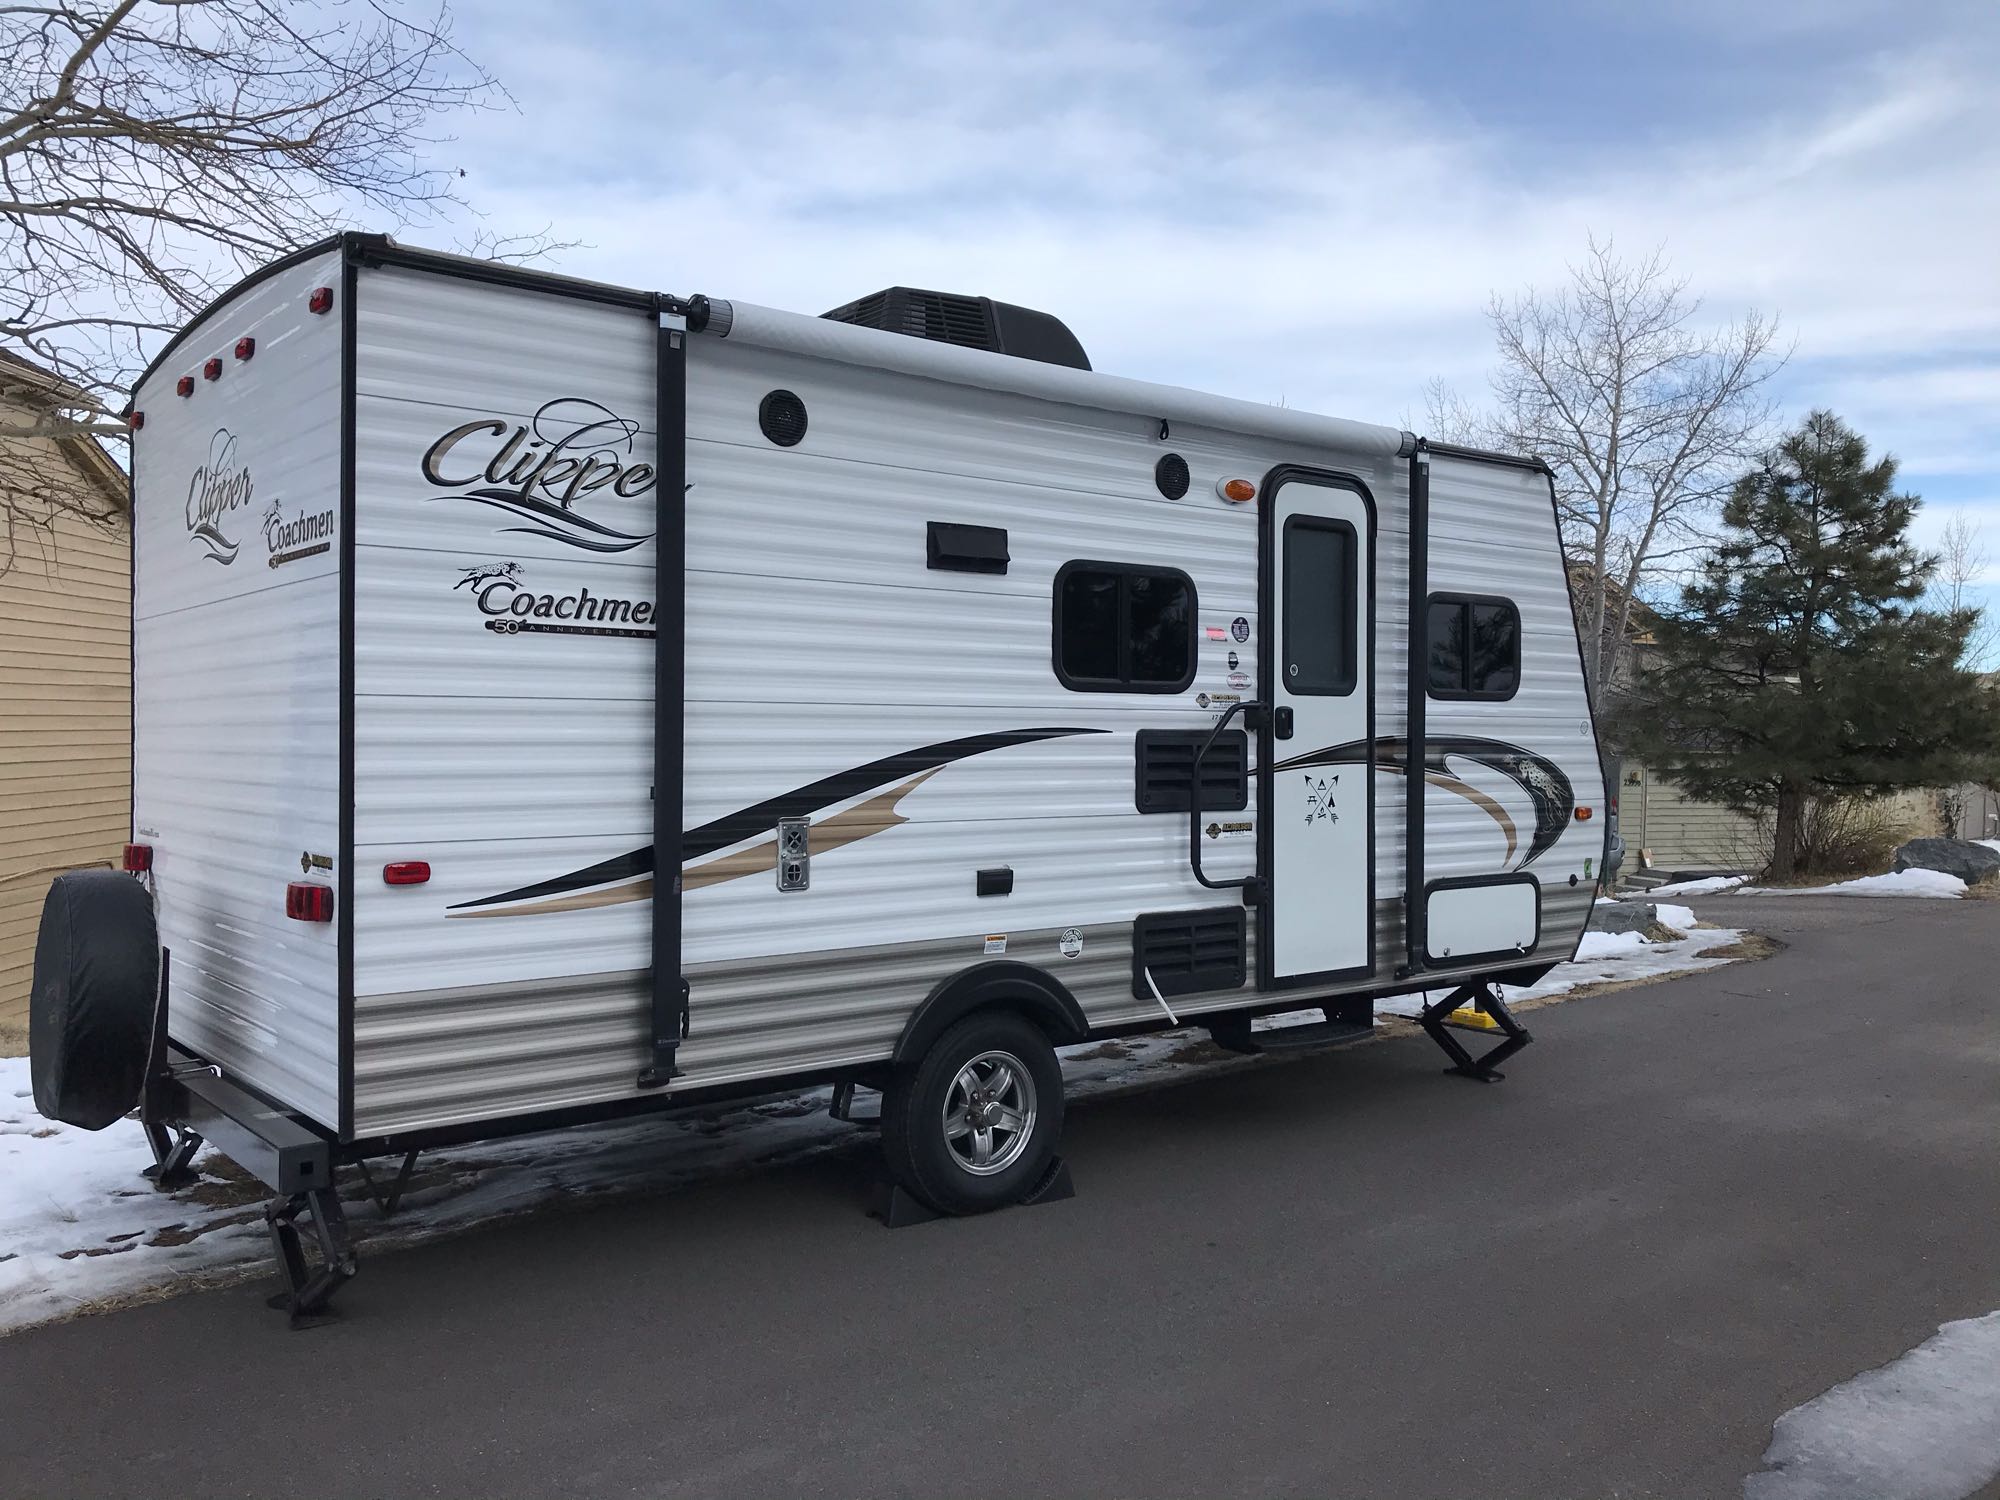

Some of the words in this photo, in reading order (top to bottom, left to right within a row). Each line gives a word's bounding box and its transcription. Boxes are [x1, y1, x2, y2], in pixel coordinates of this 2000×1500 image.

[421, 398, 695, 510] Clippe
[186, 428, 254, 531] Clipper
[267, 510, 335, 553] Coachmen
[477, 581, 657, 625] Coachme
[529, 624, 651, 637] ANNIVERSAR
